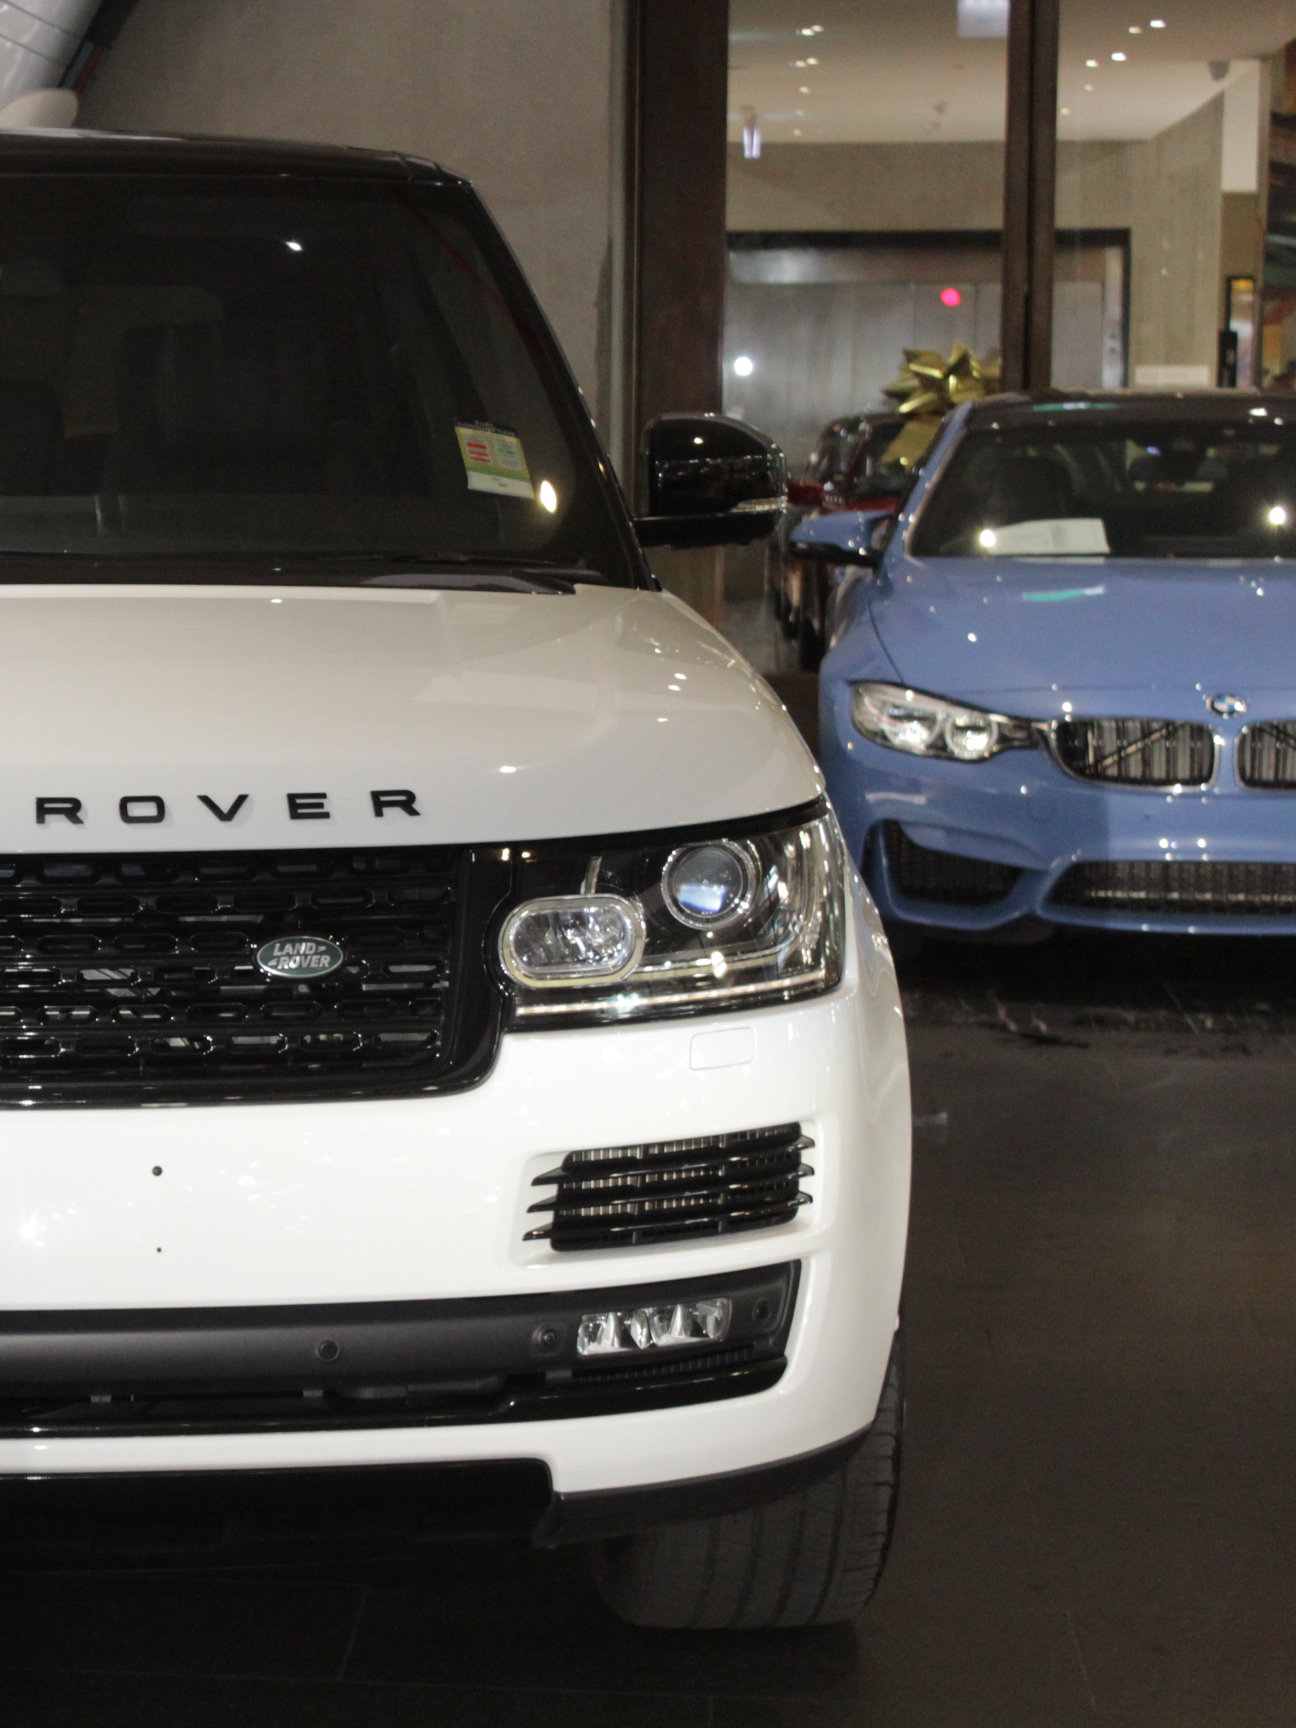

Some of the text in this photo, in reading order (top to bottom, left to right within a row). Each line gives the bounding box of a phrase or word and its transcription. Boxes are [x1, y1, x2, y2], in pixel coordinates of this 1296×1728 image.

[35, 789, 421, 824] ROVER
[274, 942, 316, 955] LAND
[278, 956, 331, 969] ROVER
